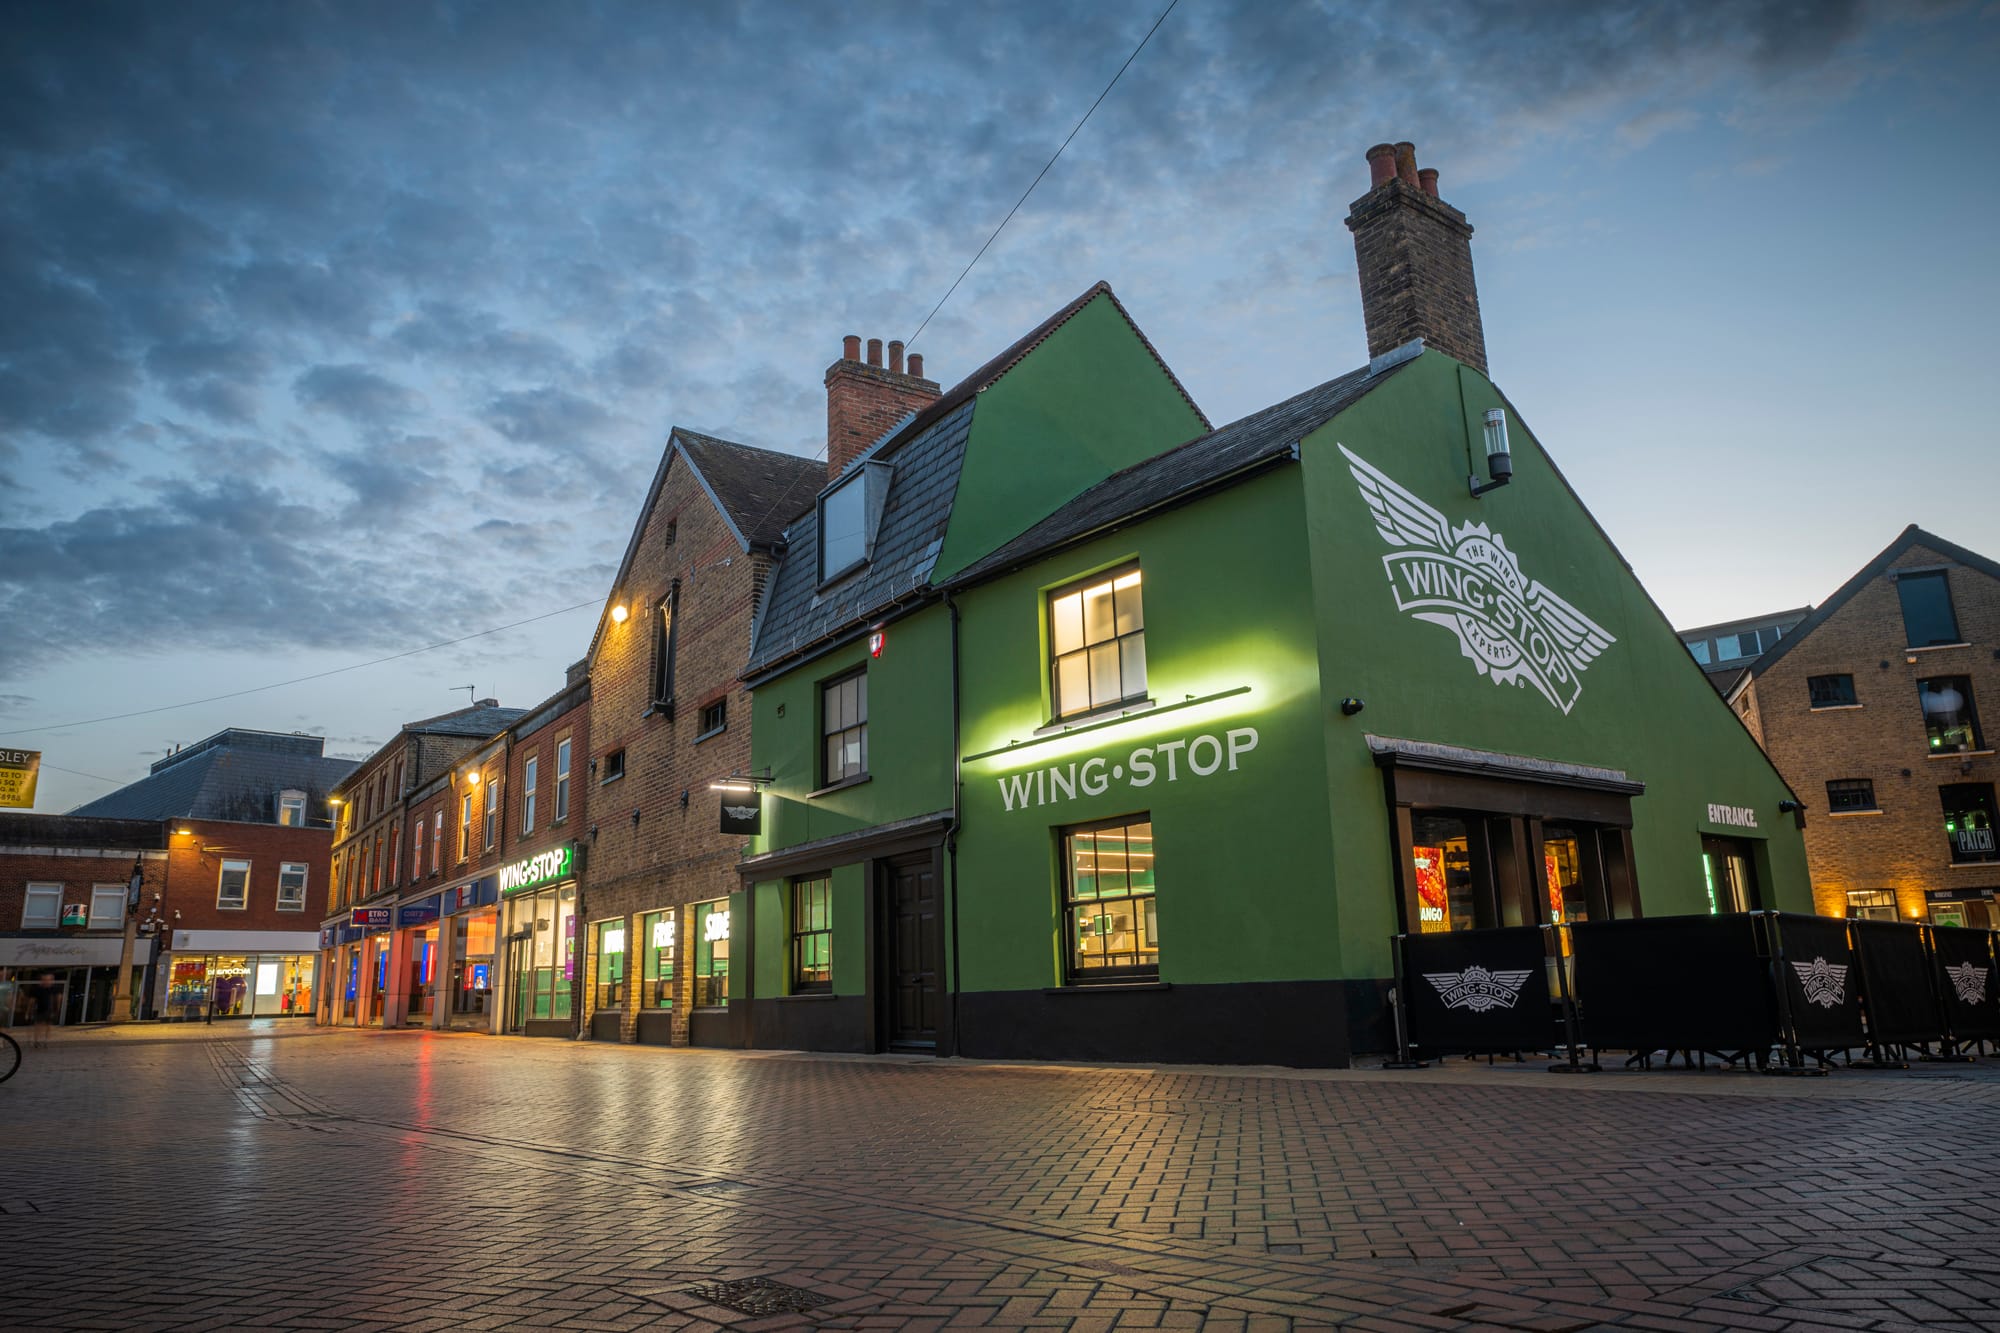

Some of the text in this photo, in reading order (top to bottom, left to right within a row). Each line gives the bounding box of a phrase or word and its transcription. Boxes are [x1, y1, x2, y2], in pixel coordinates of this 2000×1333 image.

[1466, 545, 1516, 589] THE WING
[1465, 619, 1512, 659] EXPERTS
[1959, 830, 1992, 850] PATCH
